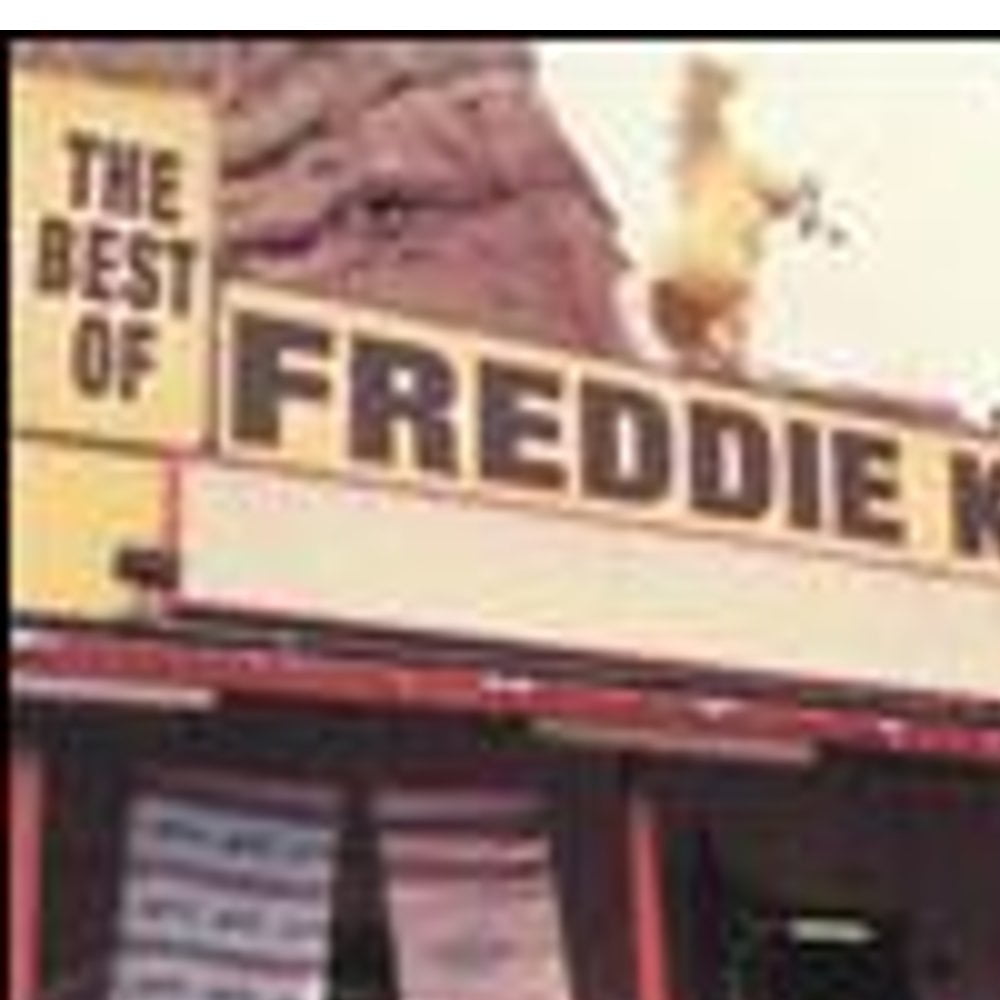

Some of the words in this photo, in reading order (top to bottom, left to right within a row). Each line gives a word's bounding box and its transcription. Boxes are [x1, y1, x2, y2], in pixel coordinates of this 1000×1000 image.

[62, 131, 182, 223] THE
[34, 218, 196, 317] BEST
[71, 314, 158, 402] OF
[229, 310, 908, 542] FREDDIE
